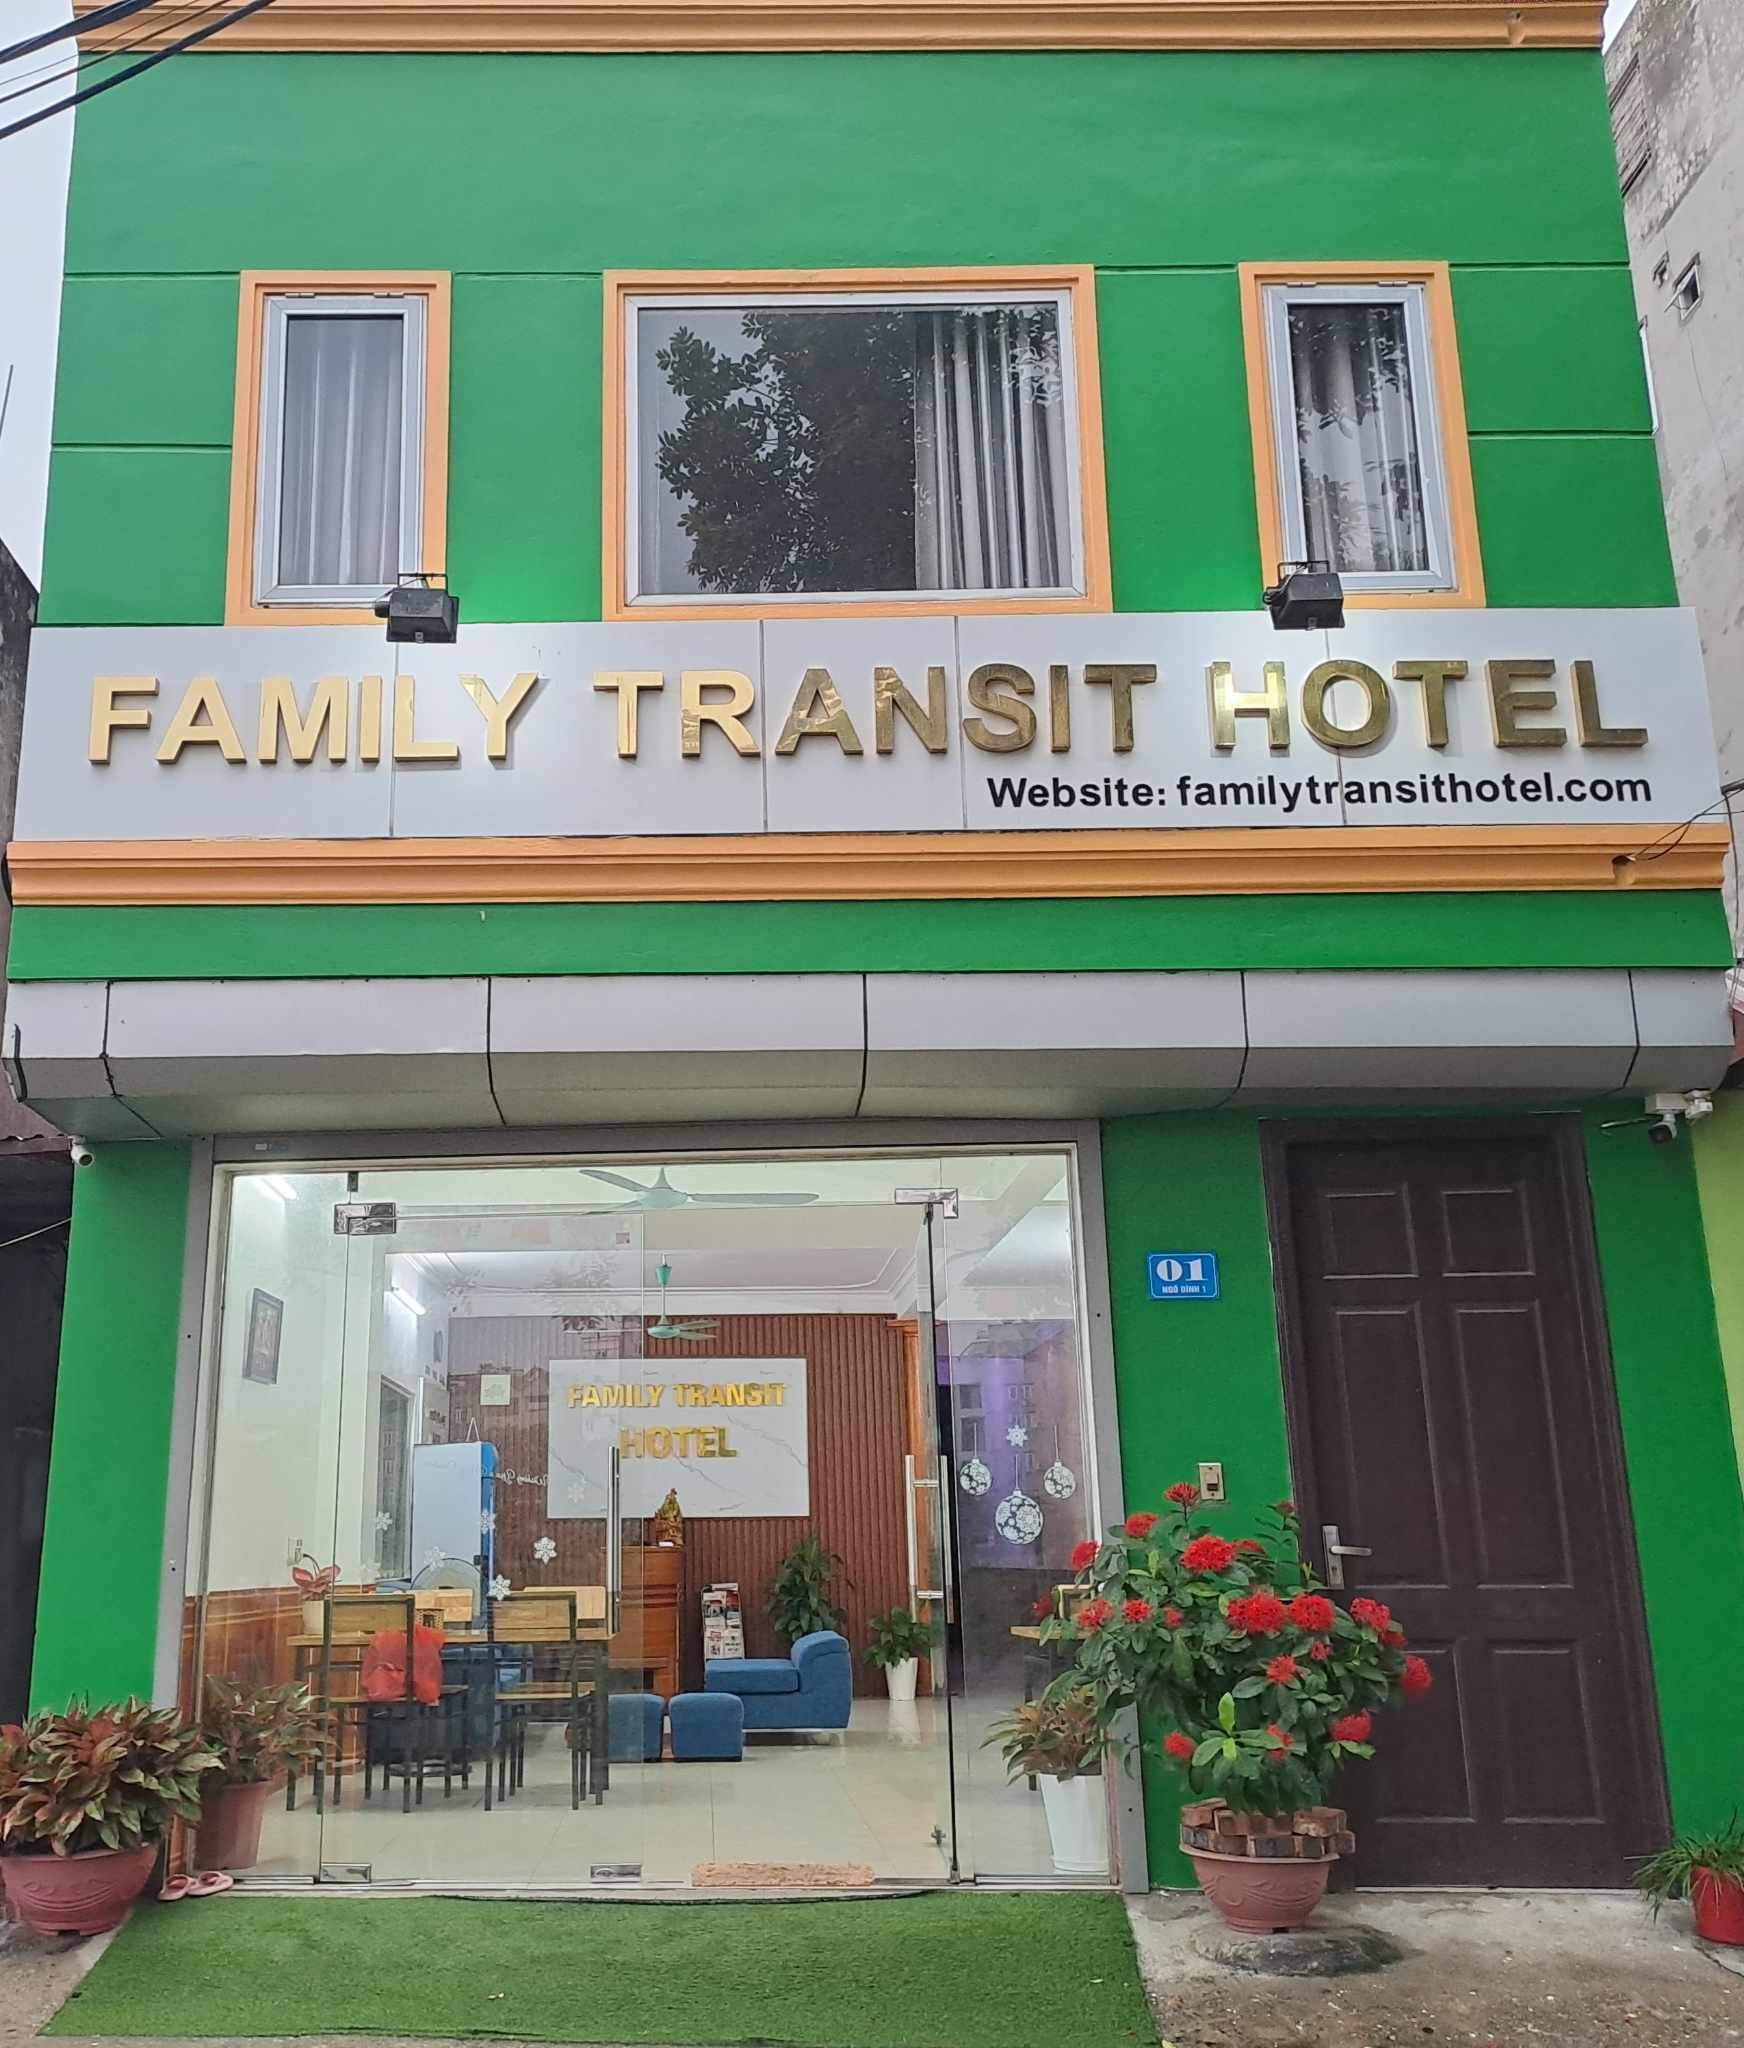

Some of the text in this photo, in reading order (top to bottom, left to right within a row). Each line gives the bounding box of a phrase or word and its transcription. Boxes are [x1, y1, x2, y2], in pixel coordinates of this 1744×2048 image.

[88, 659, 1649, 765] FAMILY TRANSIT HOTEL
[987, 772, 1652, 813] Website: familytransithotel.com
[1156, 1258, 1209, 1282] 01
[567, 1382, 786, 1409] FAMILY TRANSIT
[618, 1425, 738, 1460] HOTEL
